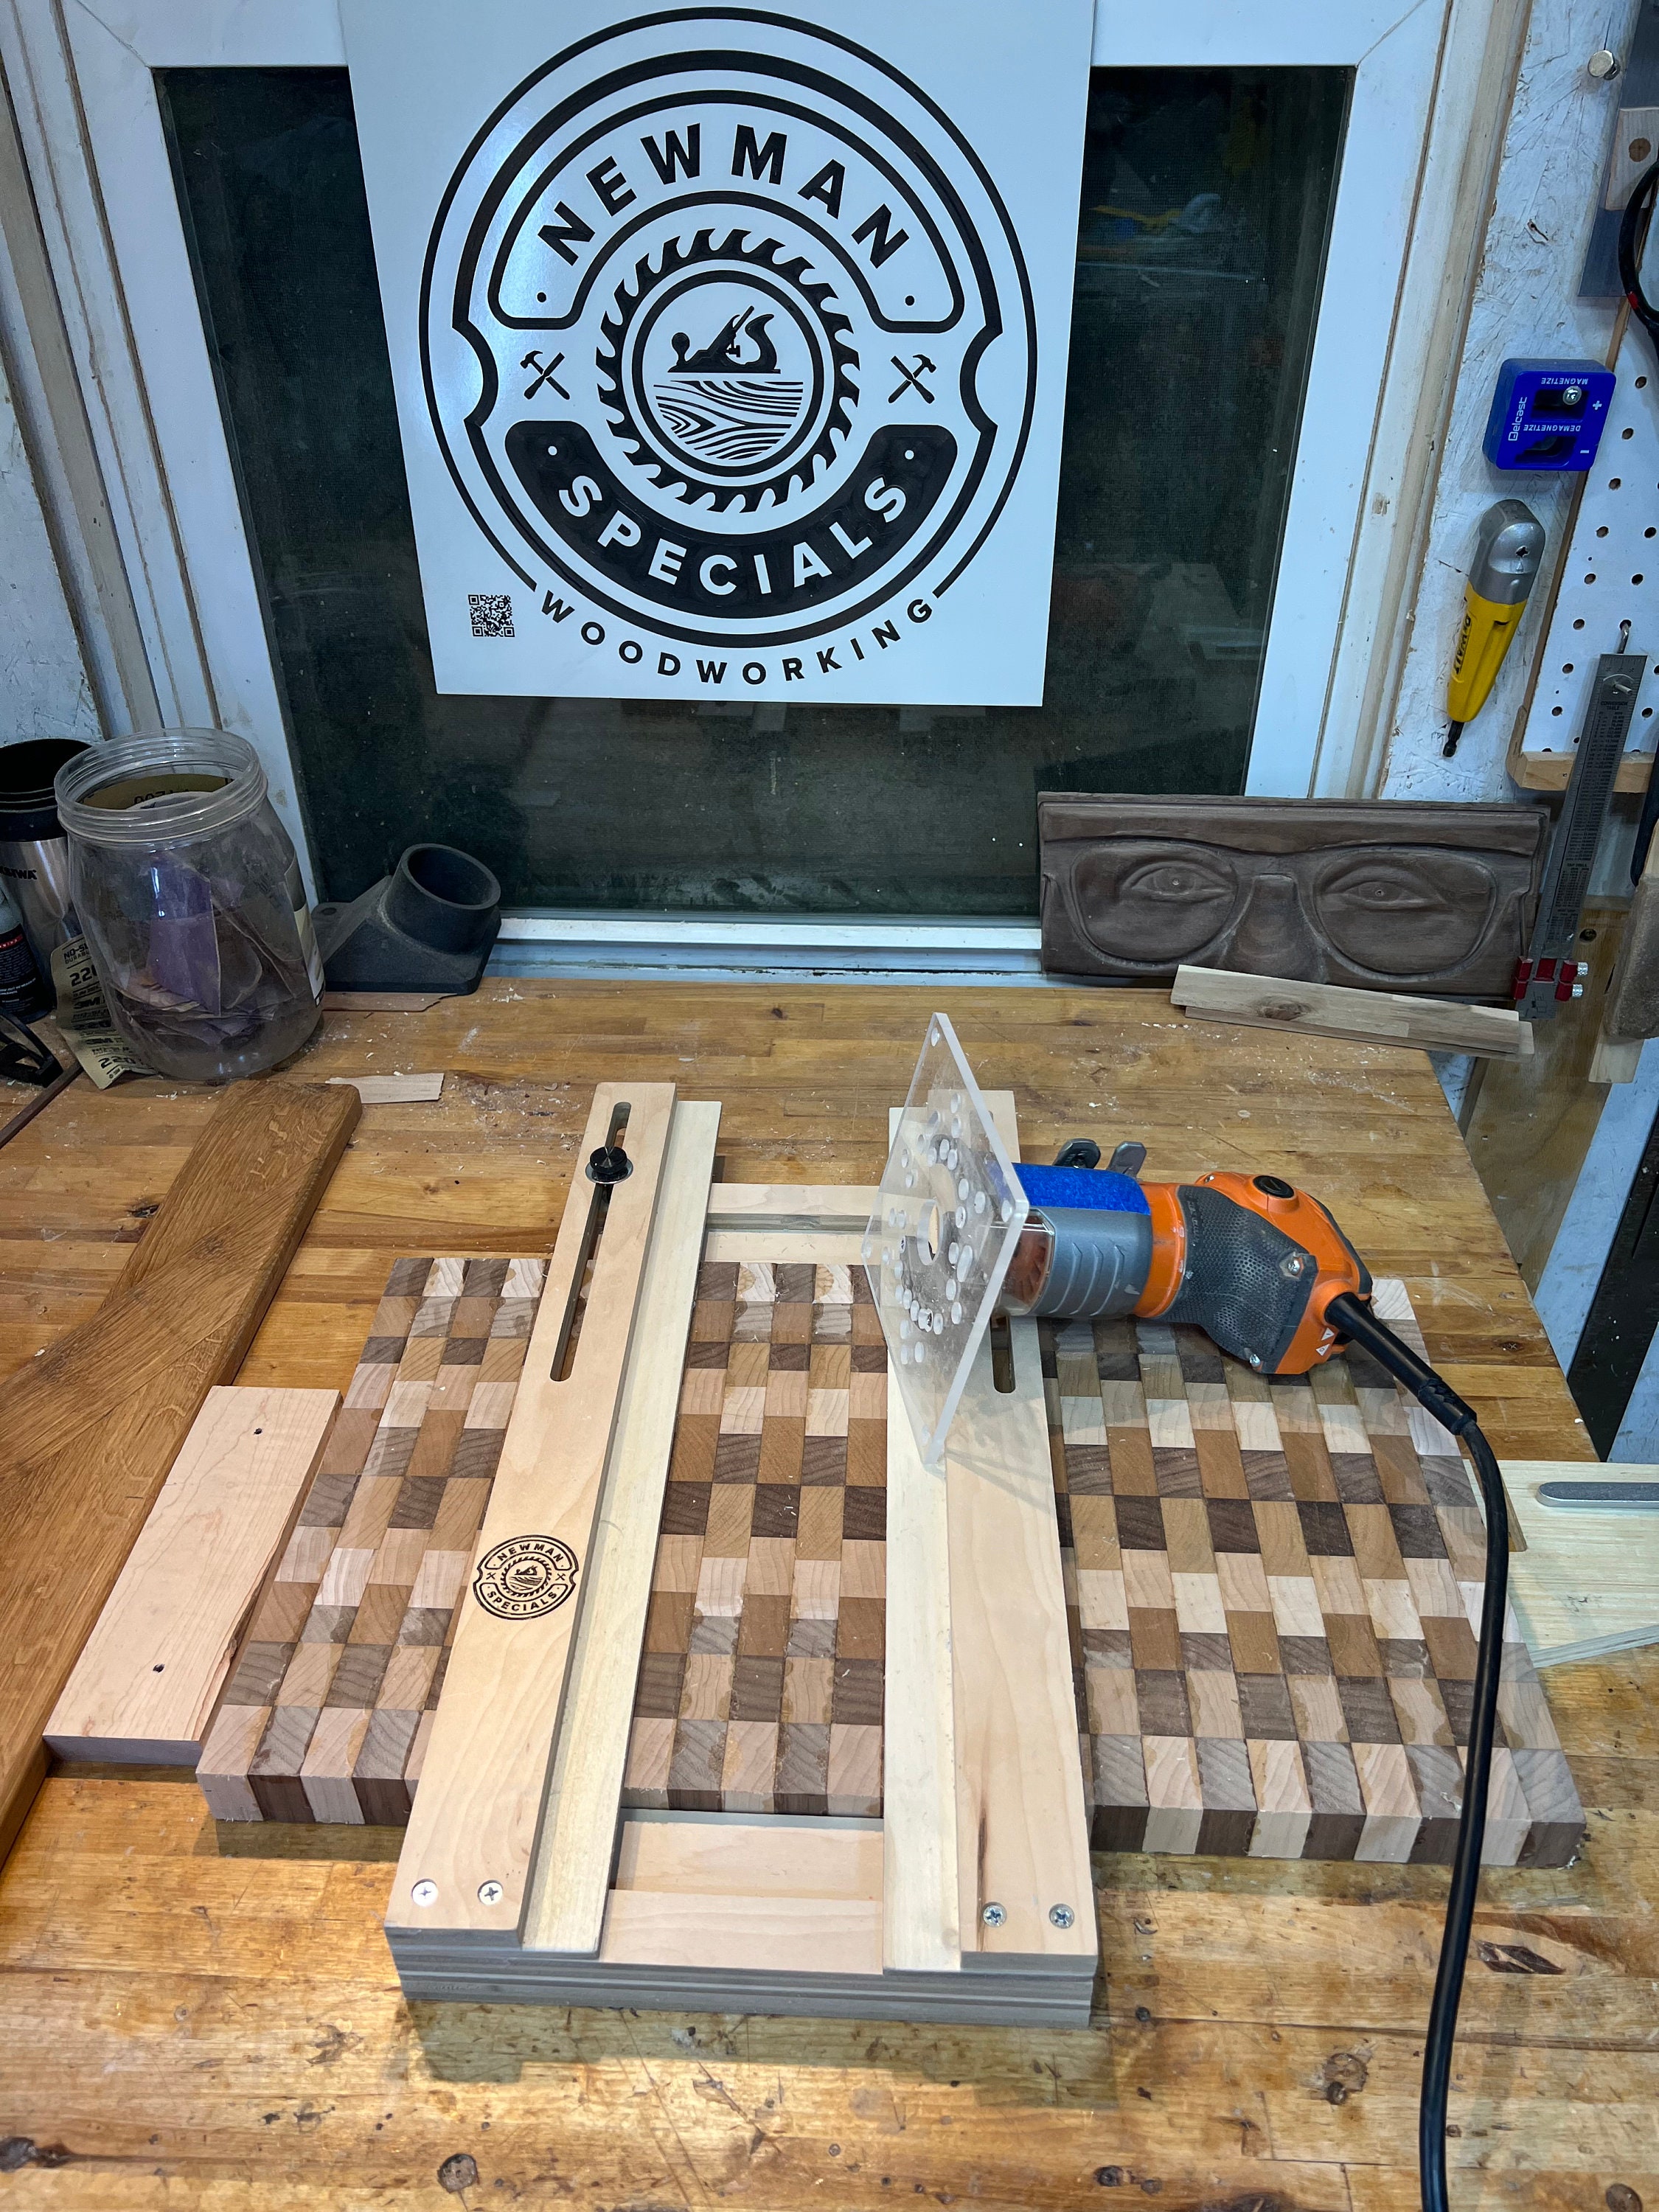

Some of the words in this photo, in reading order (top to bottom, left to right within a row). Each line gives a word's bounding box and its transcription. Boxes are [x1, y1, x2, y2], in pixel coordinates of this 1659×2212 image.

[538, 123, 910, 268] NEWMAN
[558, 475, 906, 595] SPECIALS
[541, 590, 933, 684] WOODWORKING
[497, 1543, 564, 1562] NEWMAN
[487, 1590, 557, 1611] SPECIALS
